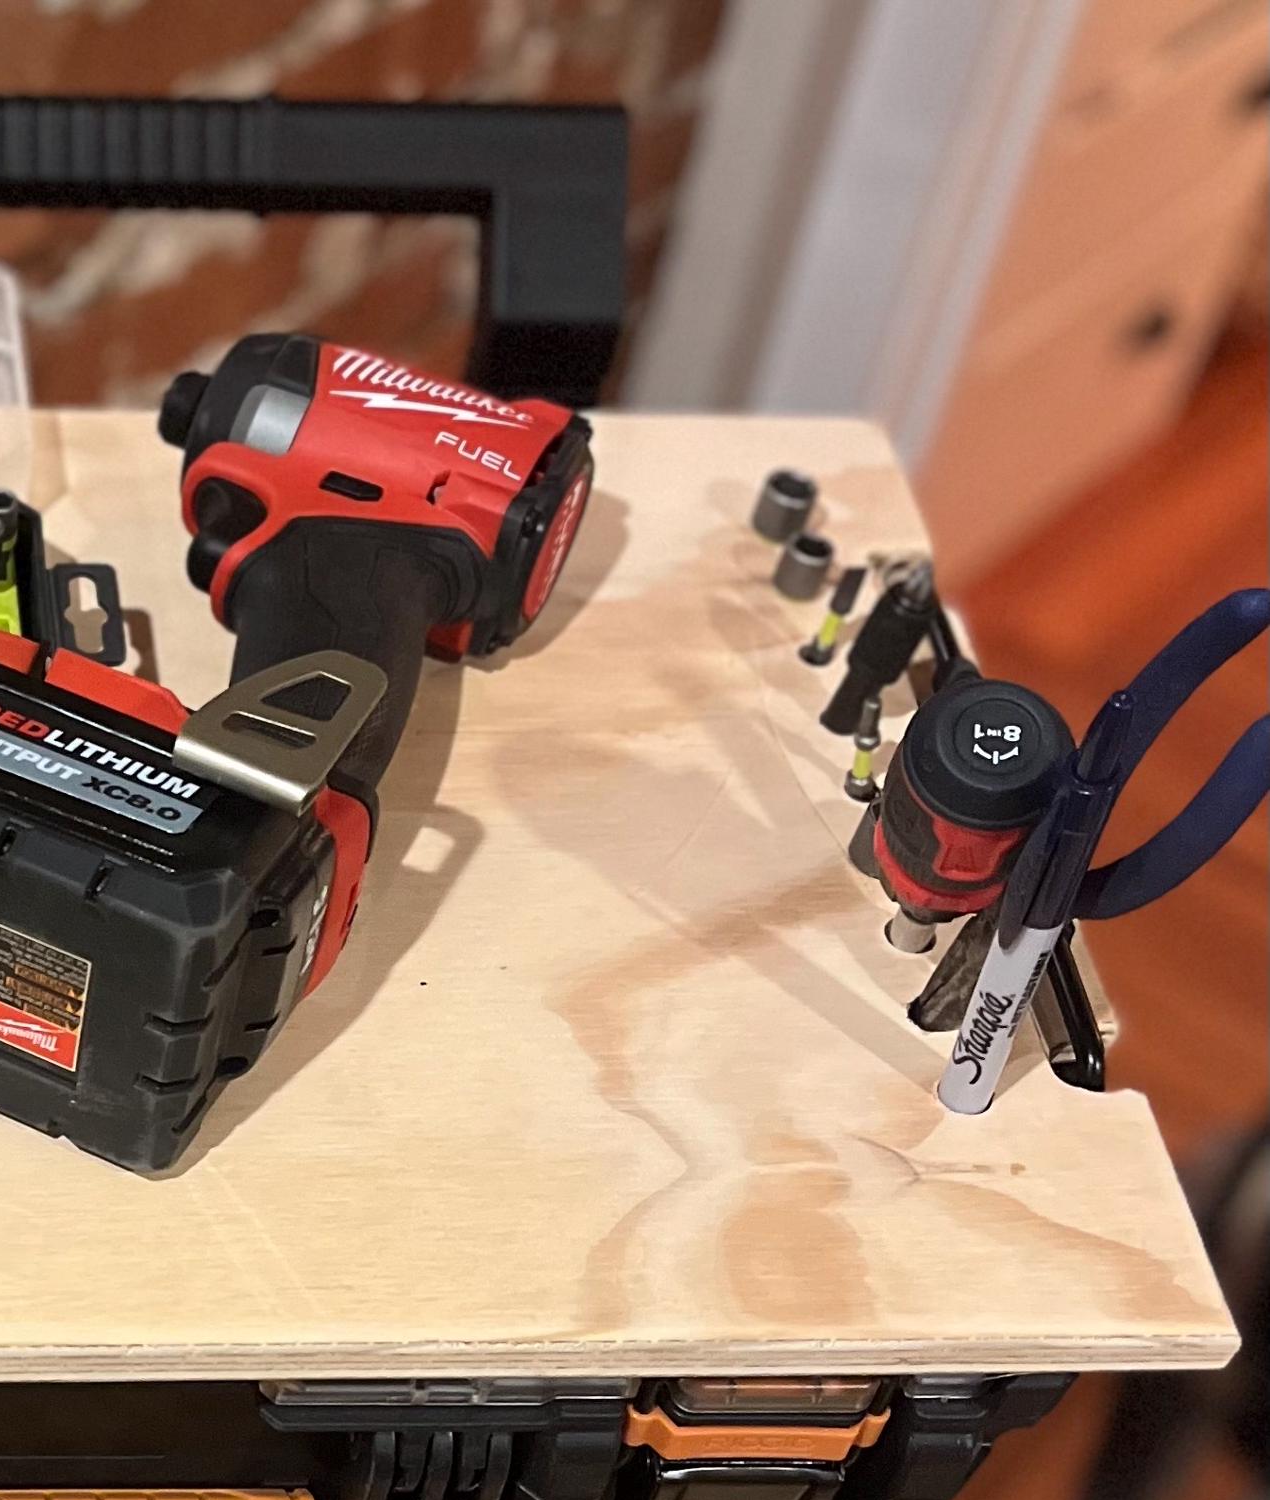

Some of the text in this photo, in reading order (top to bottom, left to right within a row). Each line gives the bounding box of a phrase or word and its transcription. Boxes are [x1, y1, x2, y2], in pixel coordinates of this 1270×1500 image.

[332, 350, 533, 423] Milwaukee
[434, 431, 522, 481] FUEL
[974, 723, 985, 739] 1
[1003, 725, 1021, 742] 8
[82, 775, 182, 822] XC8.0
[952, 990, 1013, 1085] Sharpie
